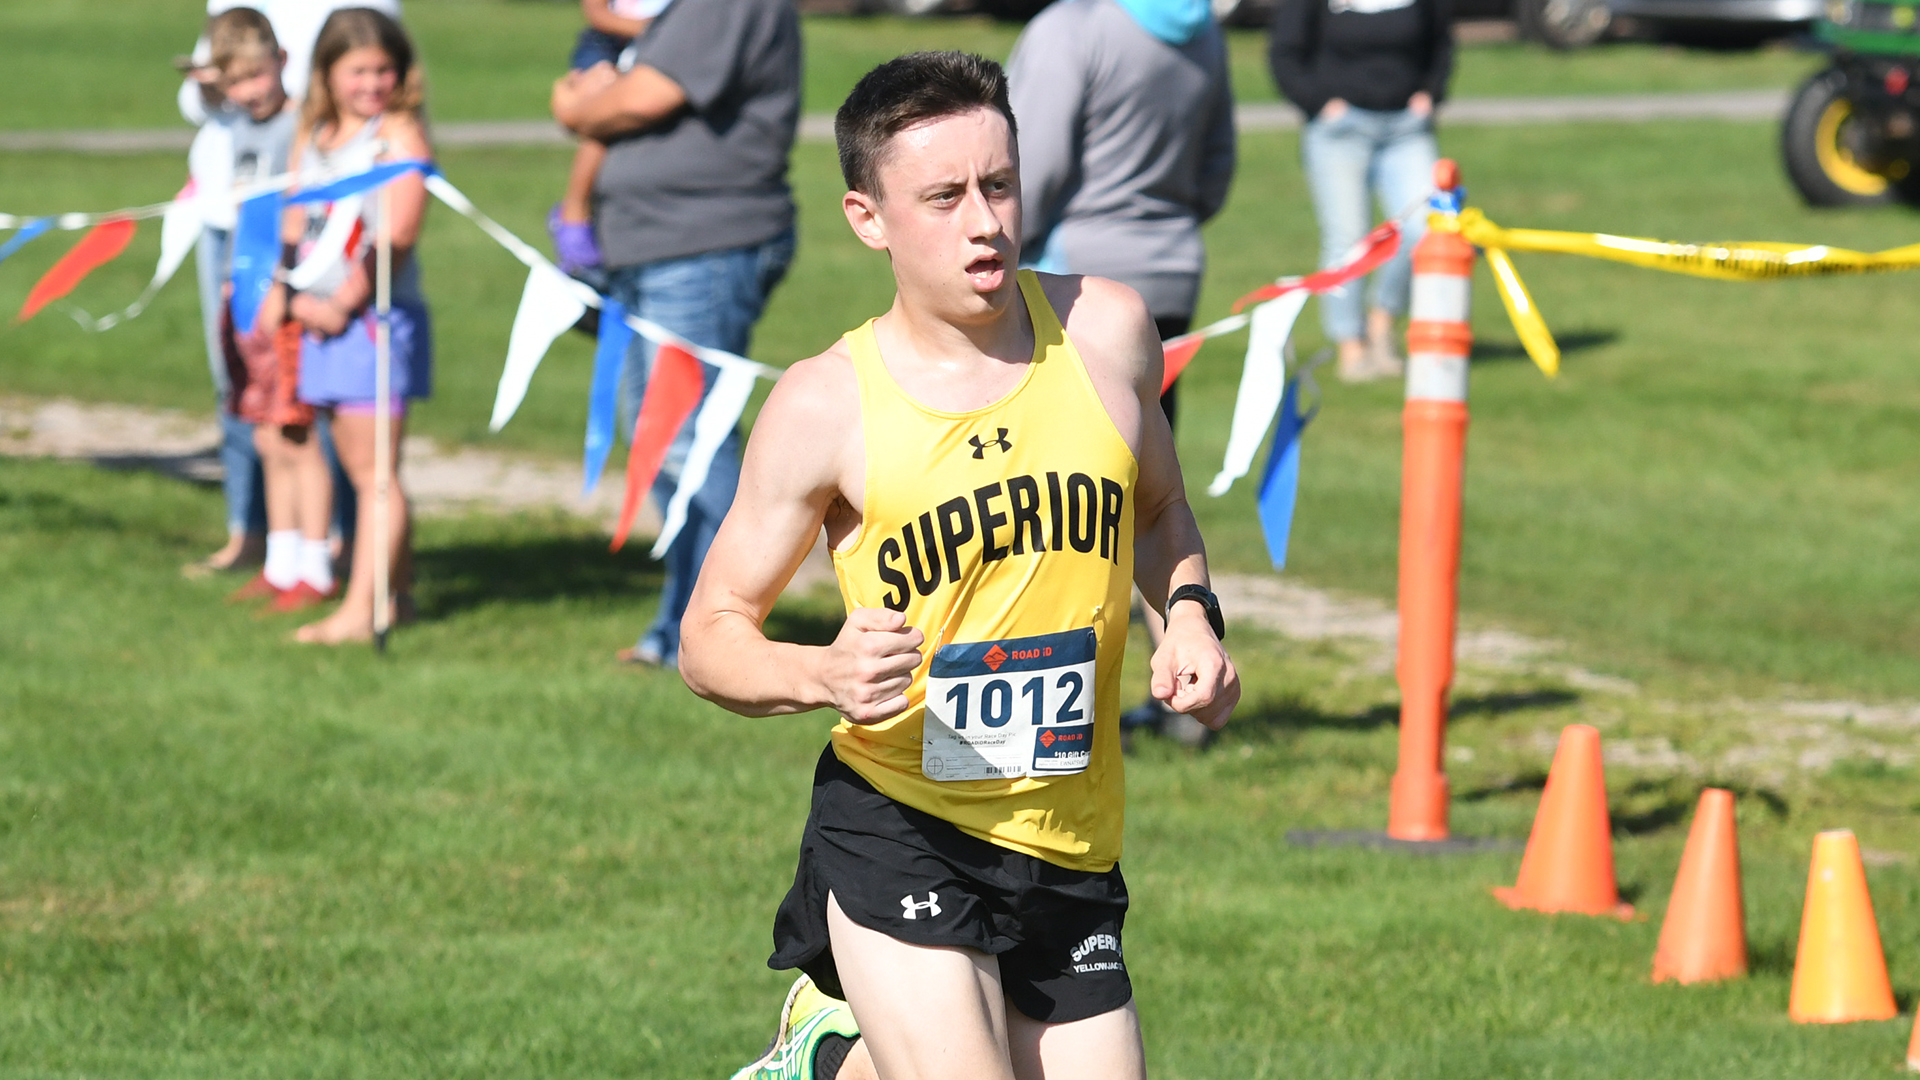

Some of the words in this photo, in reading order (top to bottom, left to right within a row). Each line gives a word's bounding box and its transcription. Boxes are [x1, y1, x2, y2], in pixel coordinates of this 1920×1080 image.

[877, 471, 1124, 613] SUPERIOR
[1011, 648, 1041, 660] ROAD
[945, 671, 1084, 730] 1012
[1070, 933, 1122, 962] SUPERI
